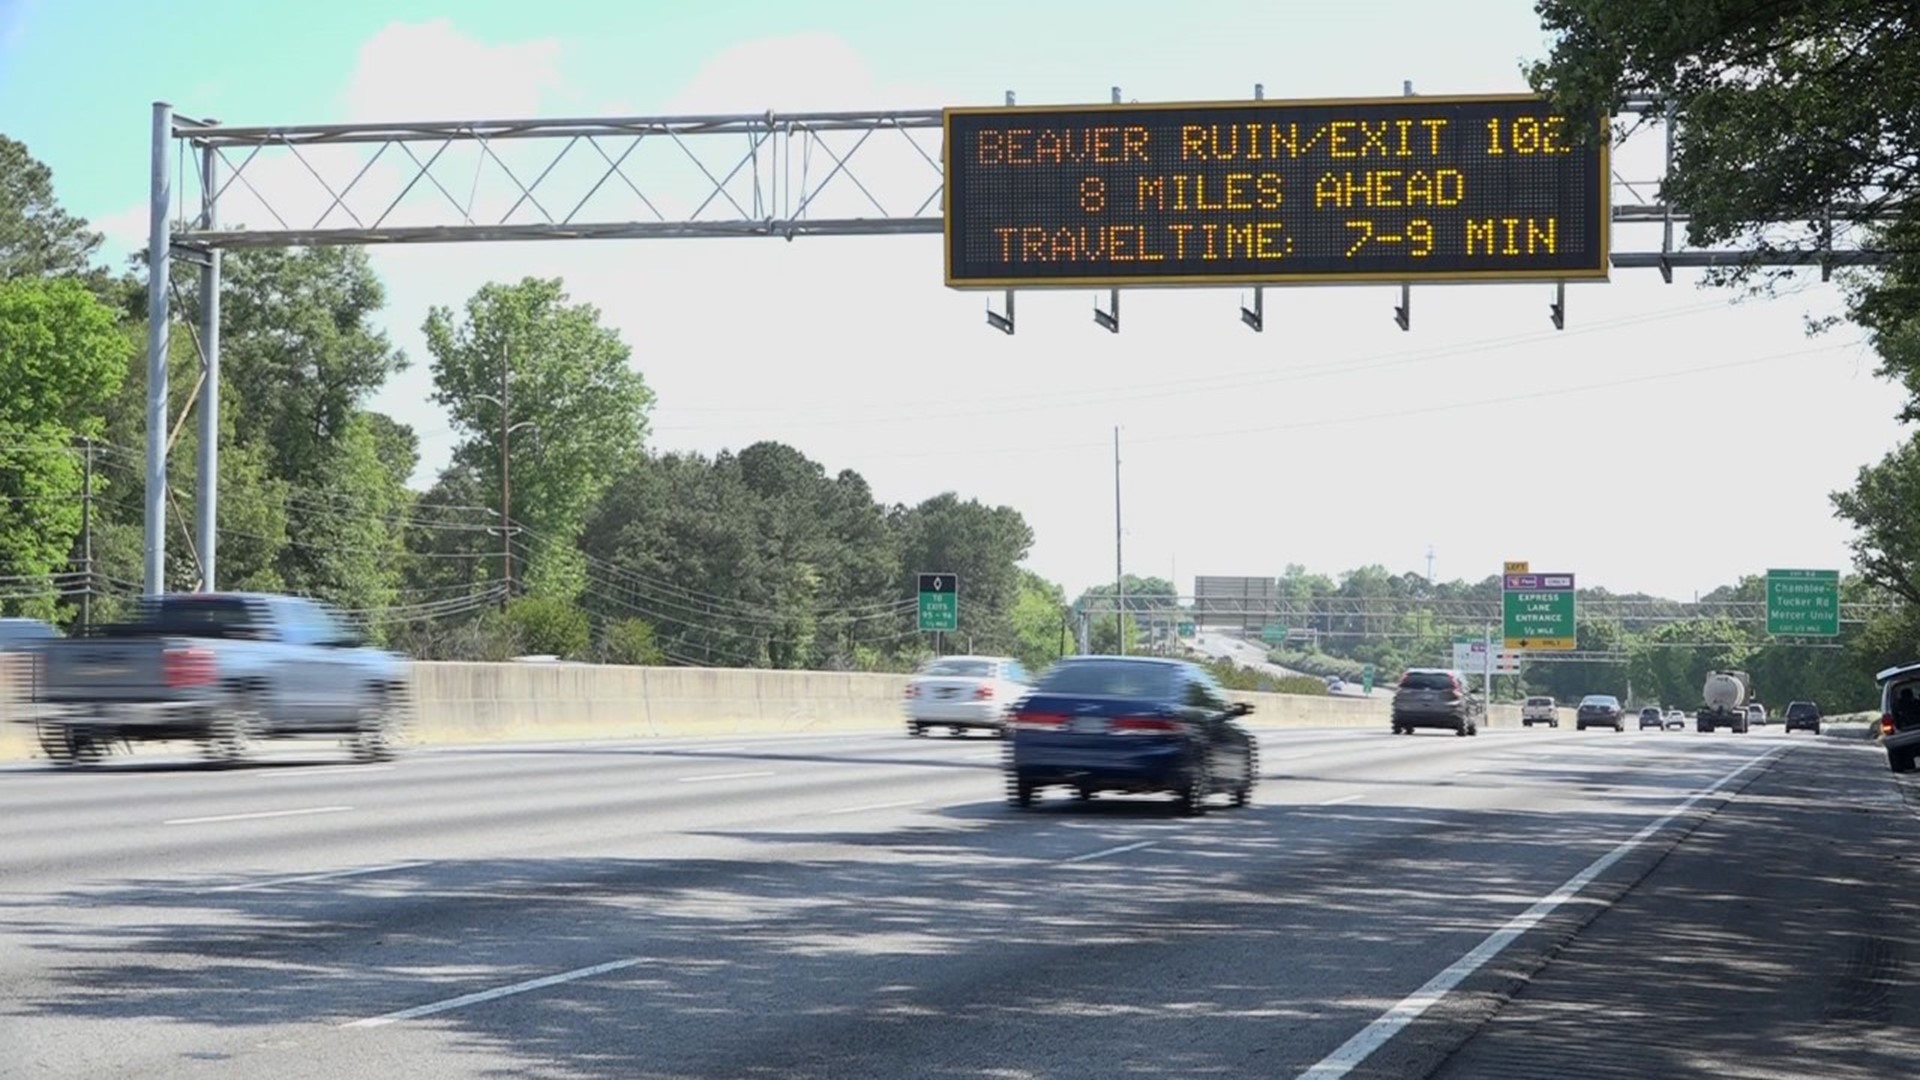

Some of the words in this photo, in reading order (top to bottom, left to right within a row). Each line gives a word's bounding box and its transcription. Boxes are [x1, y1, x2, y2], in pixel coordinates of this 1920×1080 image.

[978, 126, 1149, 164] BEAVER
[1182, 118, 1447, 161] RUIN/EXIT
[1080, 175, 1106, 212] 8
[1137, 172, 1283, 211] MILES
[1315, 168, 1465, 207] AHEAD
[1346, 218, 1434, 257] 7-9
[1465, 217, 1556, 256] MIN
[1518, 593, 1559, 602] EXPRESS
[1777, 596, 1812, 606] Tucker
[1815, 597, 1830, 607] Rd
[1527, 603, 1551, 611] LANE
[1515, 614, 1562, 622] ENTRANCE
[1771, 610, 1806, 620] Mercer
[1810, 611, 1834, 620] Univ
[1537, 627, 1554, 635] MILE
